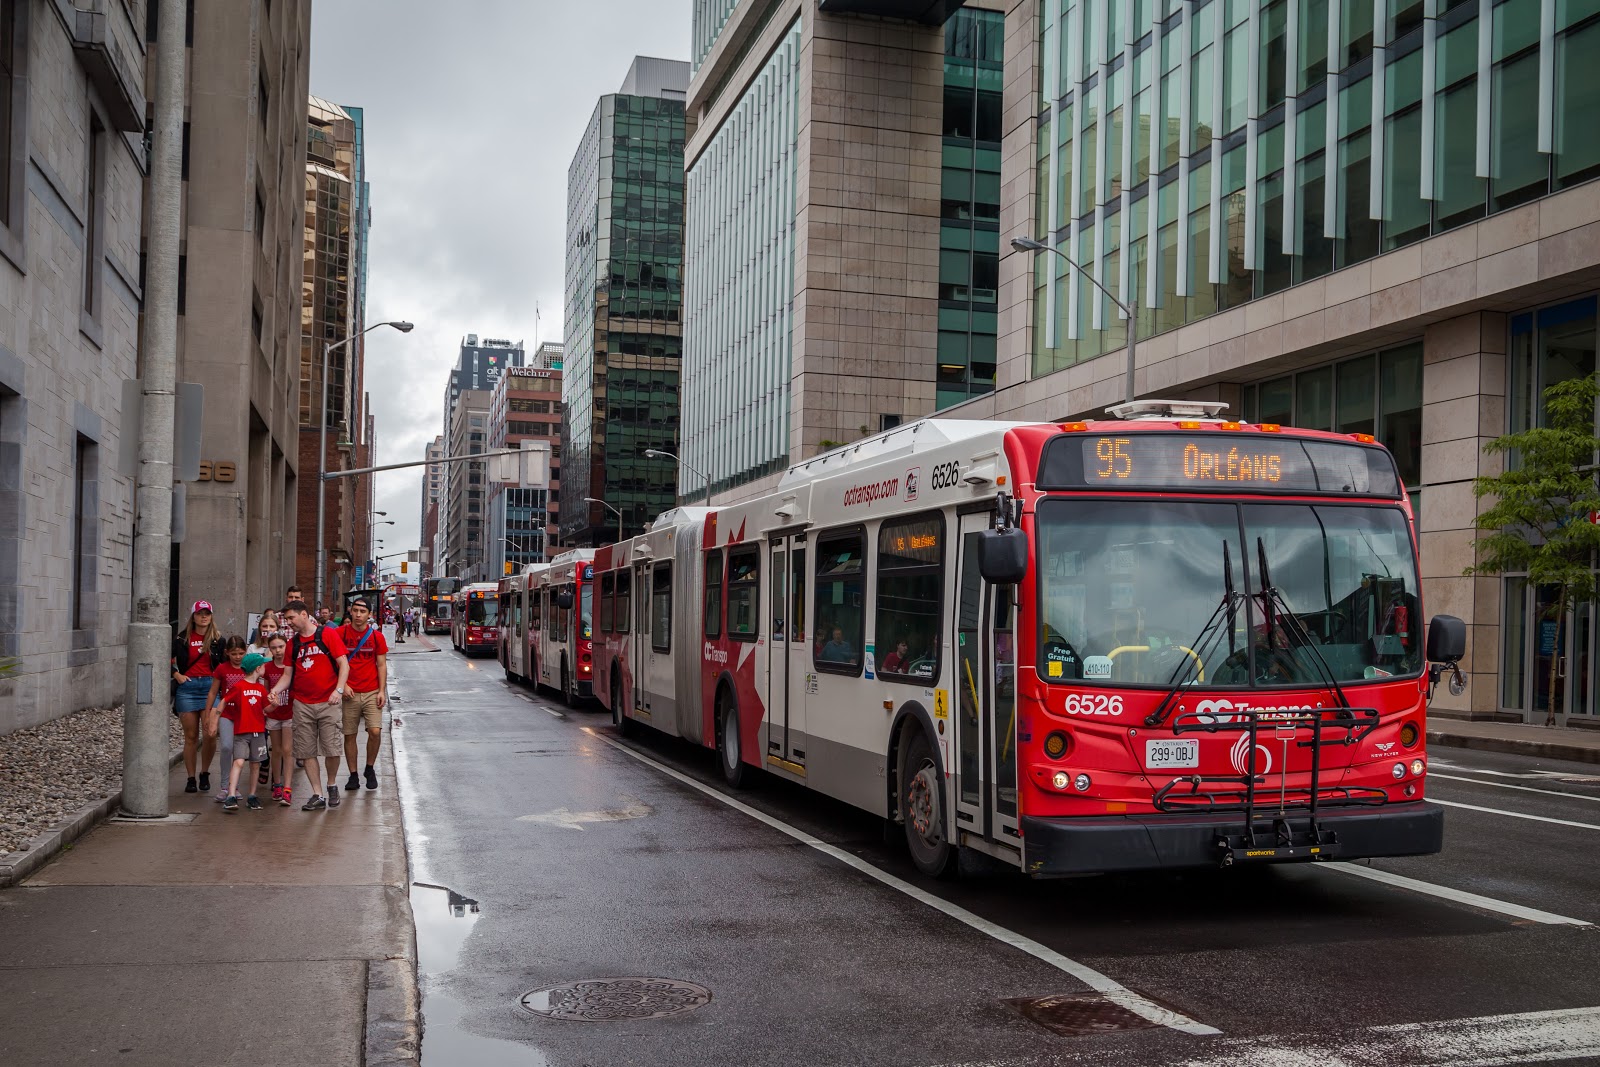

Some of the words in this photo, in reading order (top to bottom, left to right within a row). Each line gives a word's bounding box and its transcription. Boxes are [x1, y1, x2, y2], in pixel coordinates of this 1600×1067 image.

[511, 367, 537, 377] Welch
[1097, 438, 1132, 478] 95
[843, 478, 899, 508] octranspo.com
[932, 460, 959, 490] 6526
[477, 591, 485, 599] 95
[711, 645, 728, 666] Transpo
[1053, 646, 1071, 655] Free
[1047, 652, 1075, 663] Gratuit
[1087, 664, 1110, 674] 410-110
[1064, 693, 1124, 716] 6526
[1151, 747, 1170, 761] 299
